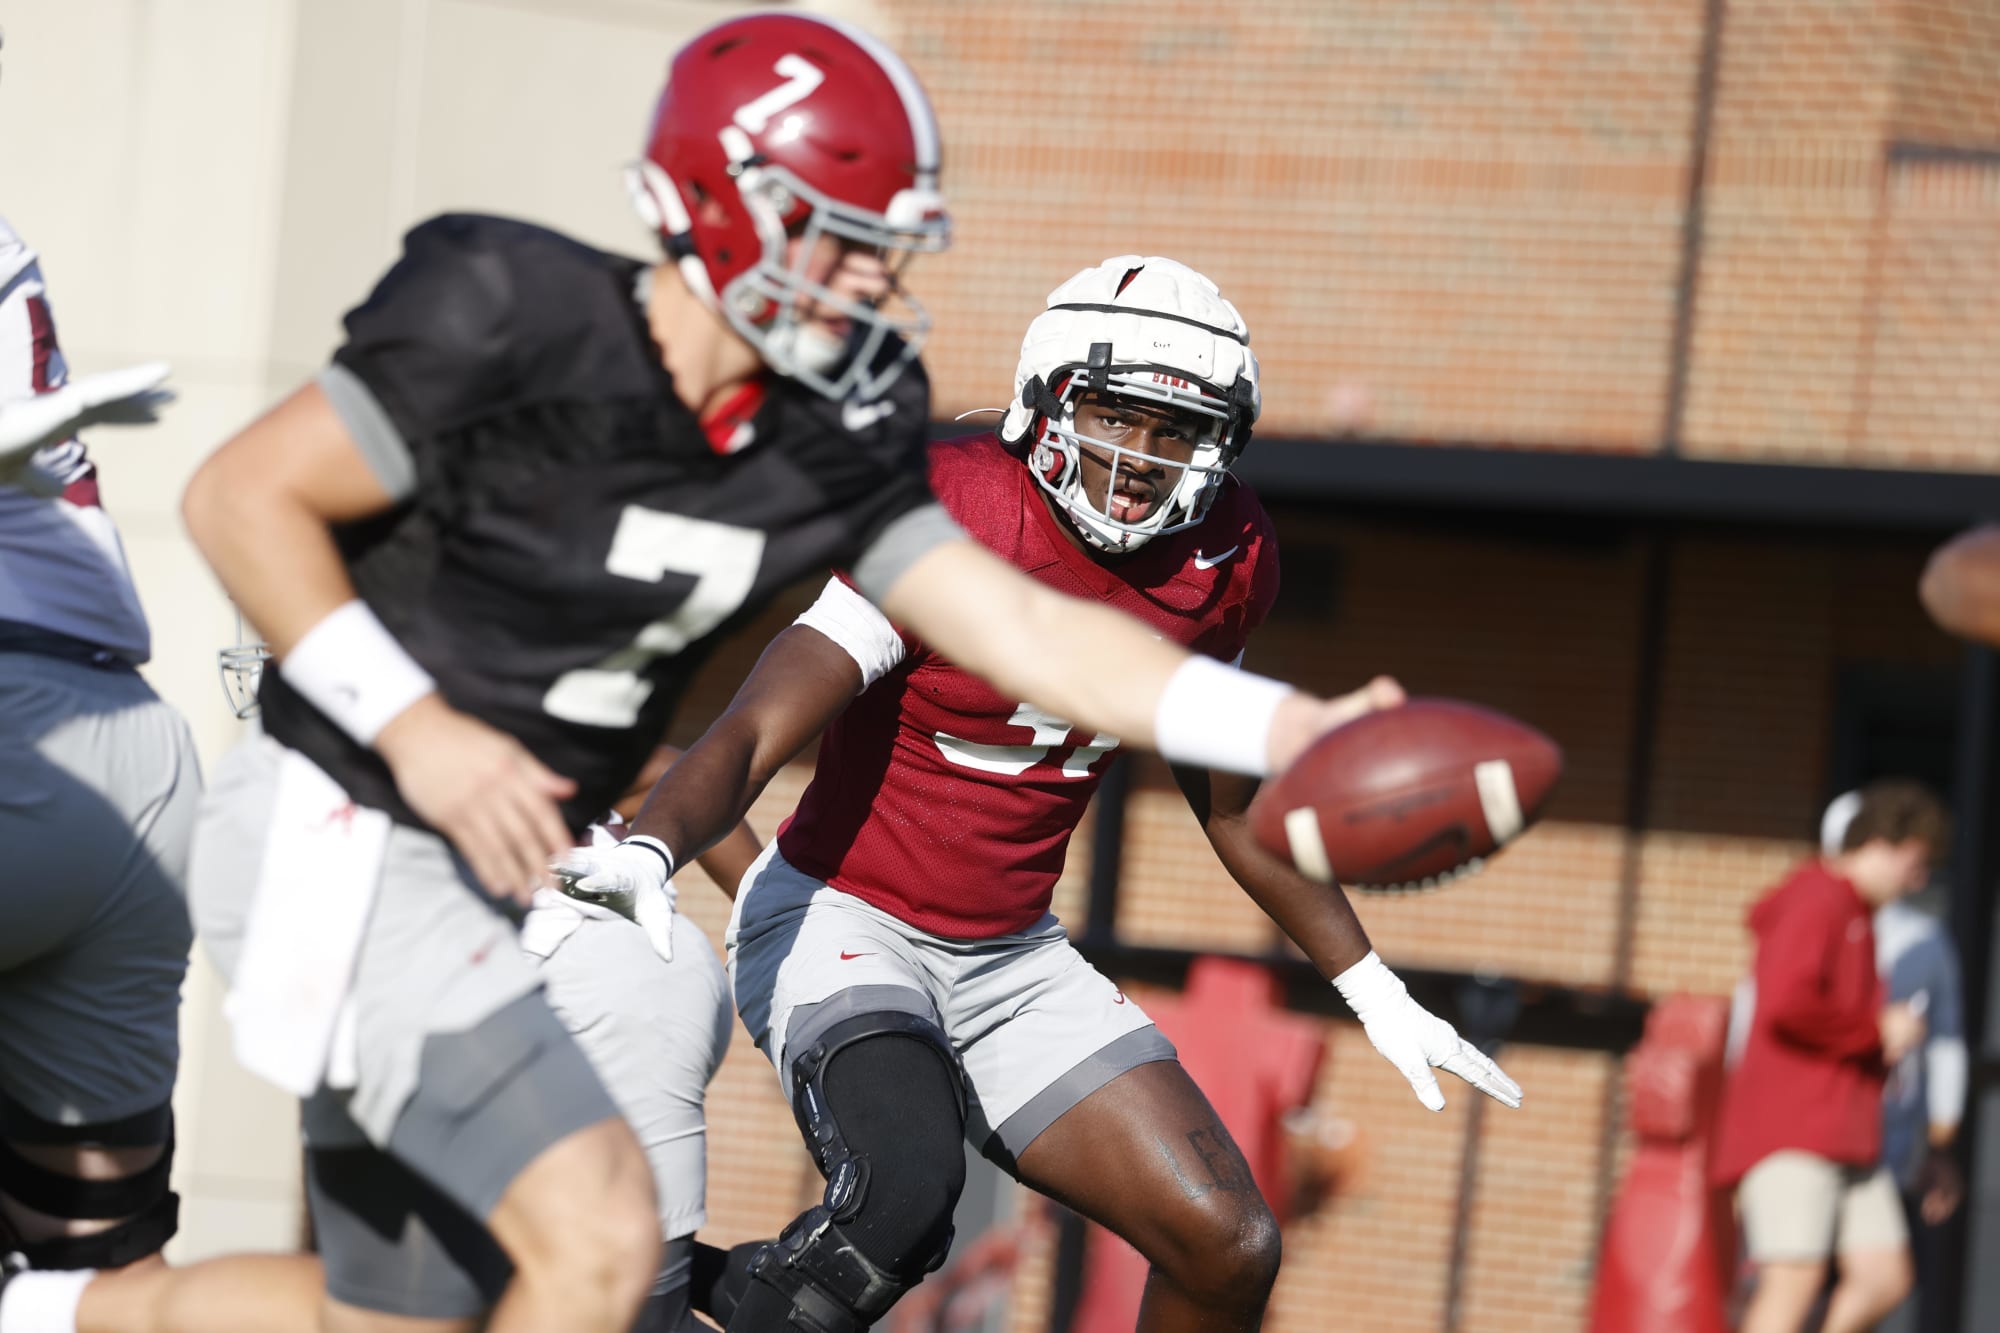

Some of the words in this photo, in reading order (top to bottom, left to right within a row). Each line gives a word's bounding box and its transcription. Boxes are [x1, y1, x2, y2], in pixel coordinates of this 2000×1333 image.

[733, 54, 825, 134] 7
[1152, 371, 1188, 390] BAMA
[542, 503, 766, 728] 7
